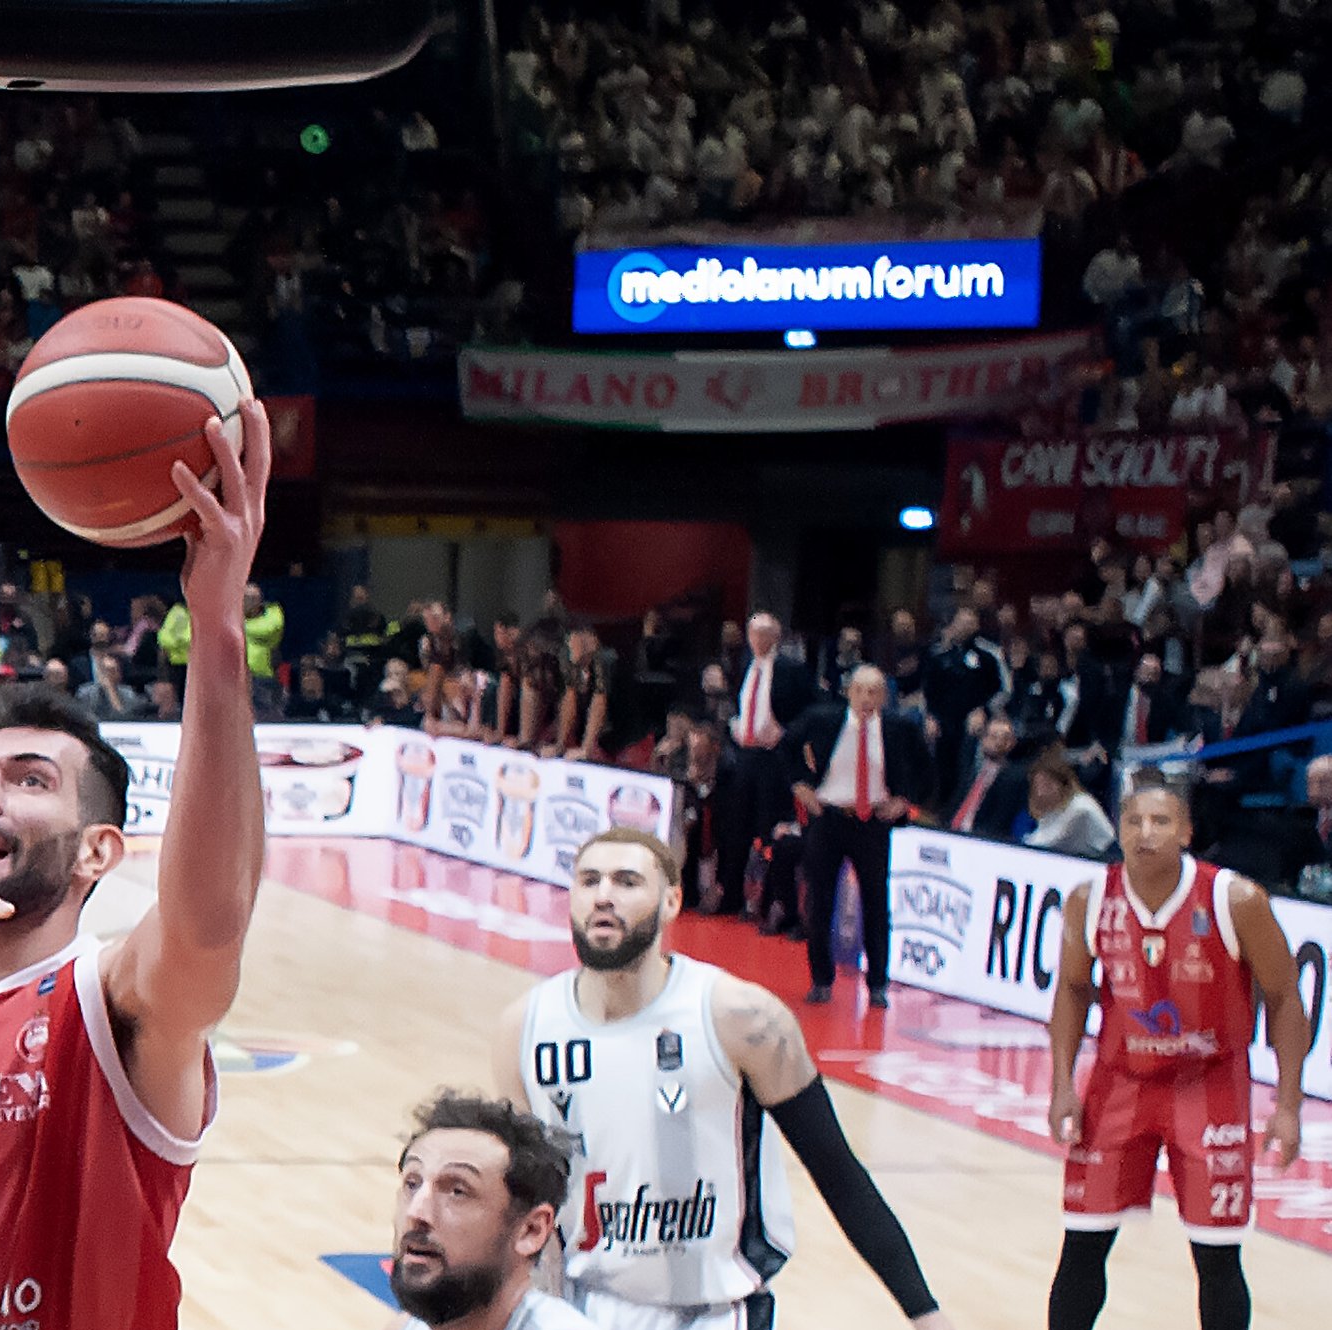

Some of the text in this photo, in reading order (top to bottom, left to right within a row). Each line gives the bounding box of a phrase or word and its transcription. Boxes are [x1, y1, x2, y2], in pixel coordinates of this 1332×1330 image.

[620, 255, 1004, 304] mediolanumforum
[467, 365, 679, 409] MILANO
[987, 877, 1063, 994] RIC
[535, 1039, 593, 1087] 00
[578, 1170, 717, 1253] Segafredo
